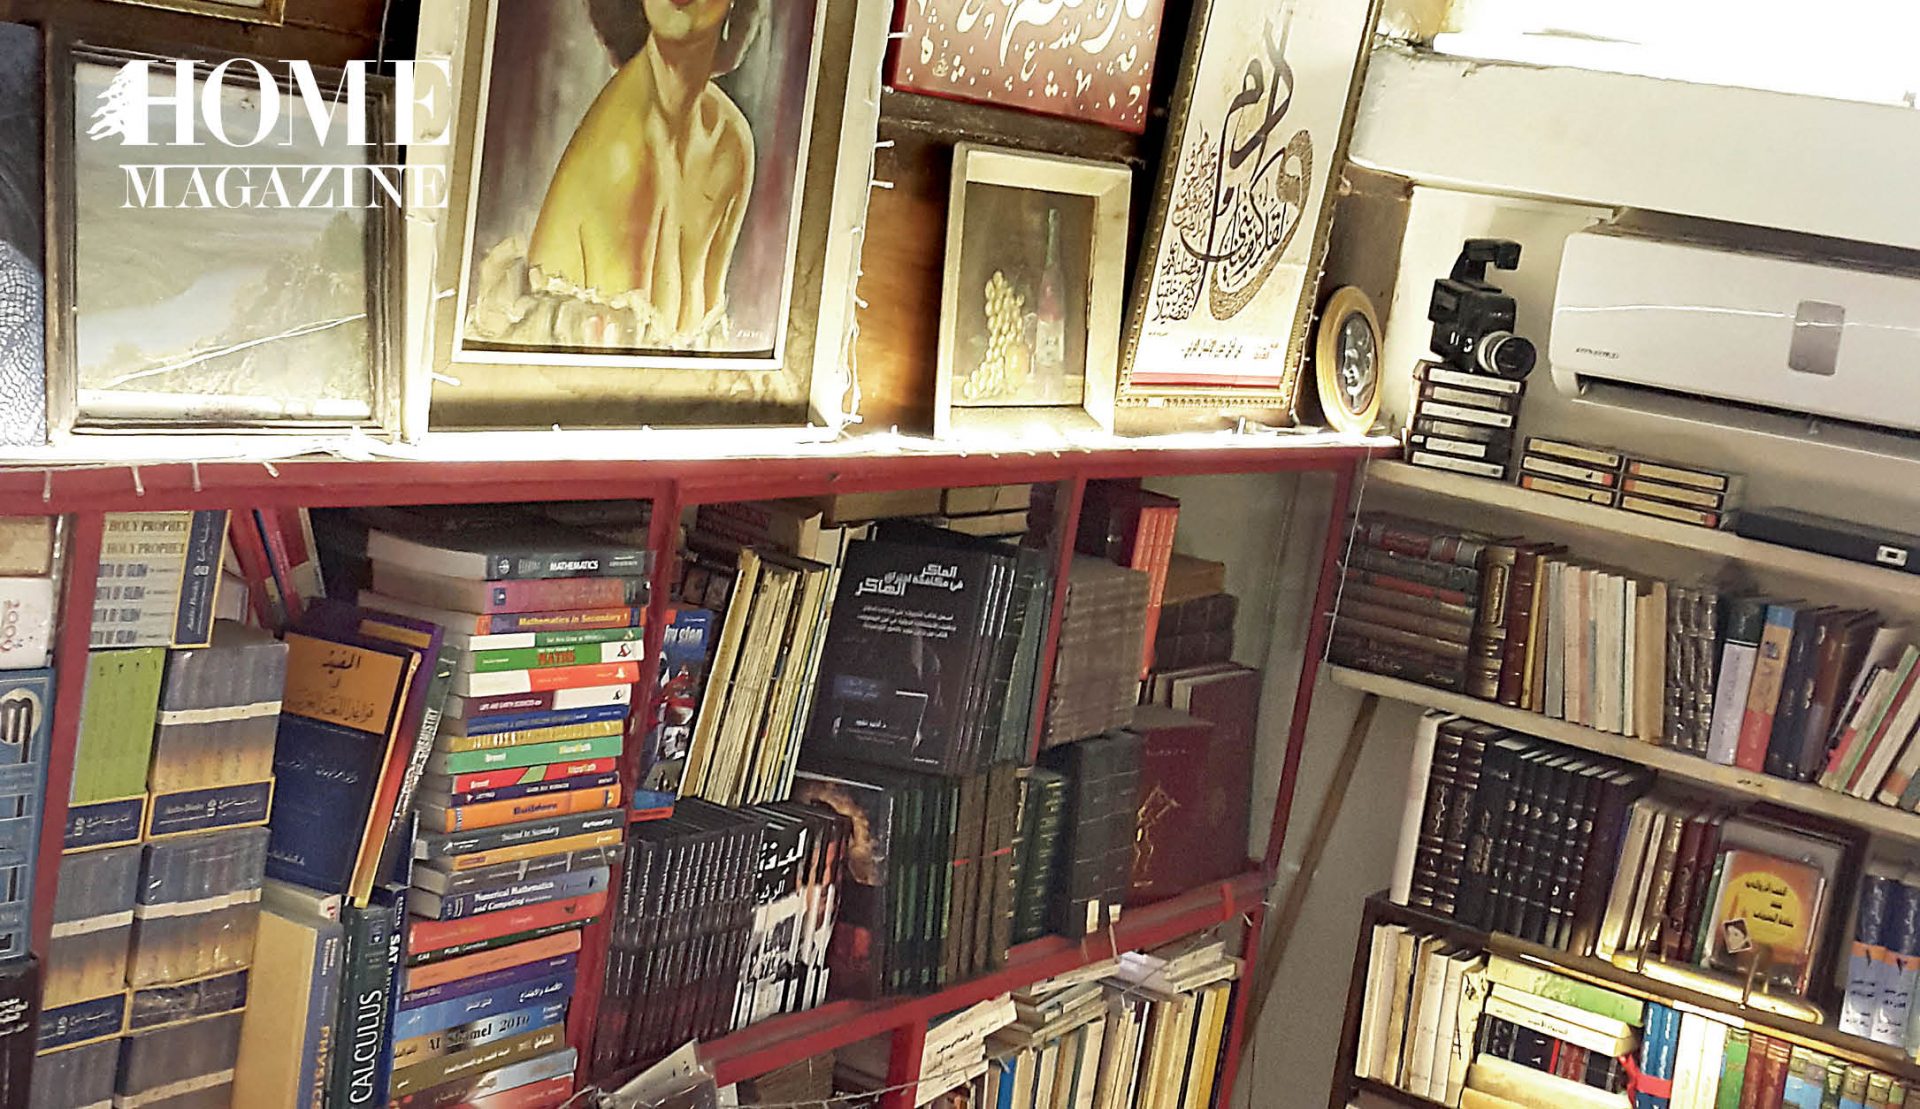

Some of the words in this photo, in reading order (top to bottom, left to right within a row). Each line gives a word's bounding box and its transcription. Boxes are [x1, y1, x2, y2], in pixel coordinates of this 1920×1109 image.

[108, 521, 138, 532] HOLY
[141, 520, 188, 532] PROPHET
[138, 543, 185, 554] PROPHET
[550, 559, 599, 572] MATHEMATICS
[519, 616, 568, 626] Mathematics
[581, 613, 621, 624] Secondary
[474, 887, 510, 902] Numerical
[511, 881, 555, 895] Mathematics
[473, 904, 487, 914] and
[487, 897, 525, 912] Computing
[387, 934, 401, 964] SAT
[499, 1015, 530, 1033] 2010
[349, 989, 383, 1104] CALCULUS
